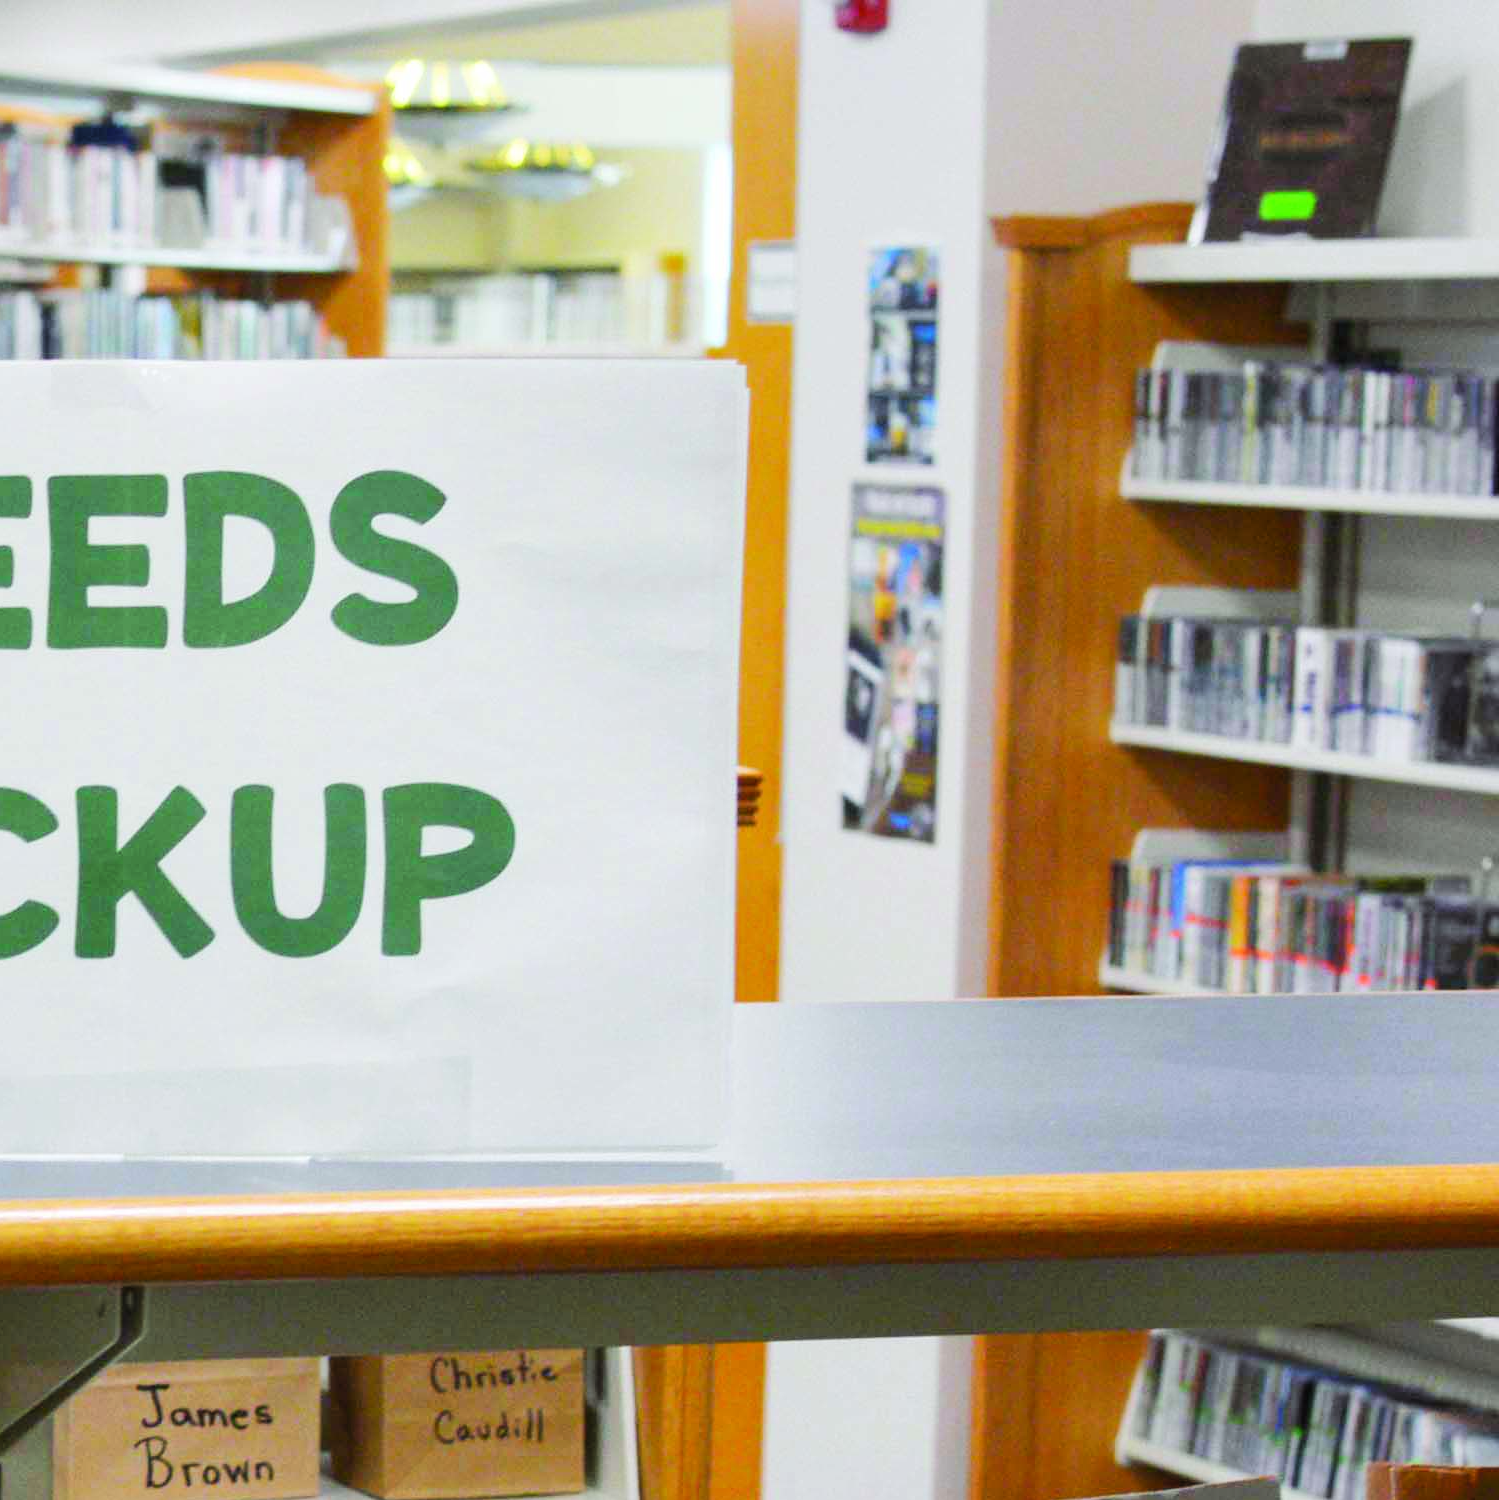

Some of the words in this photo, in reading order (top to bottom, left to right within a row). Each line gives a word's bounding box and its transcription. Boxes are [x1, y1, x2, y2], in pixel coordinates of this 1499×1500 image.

[430, 1350, 559, 1394] Christie
[136, 1383, 274, 1429] James
[434, 1408, 545, 1446] Caudill
[134, 1435, 274, 1490] Brown
